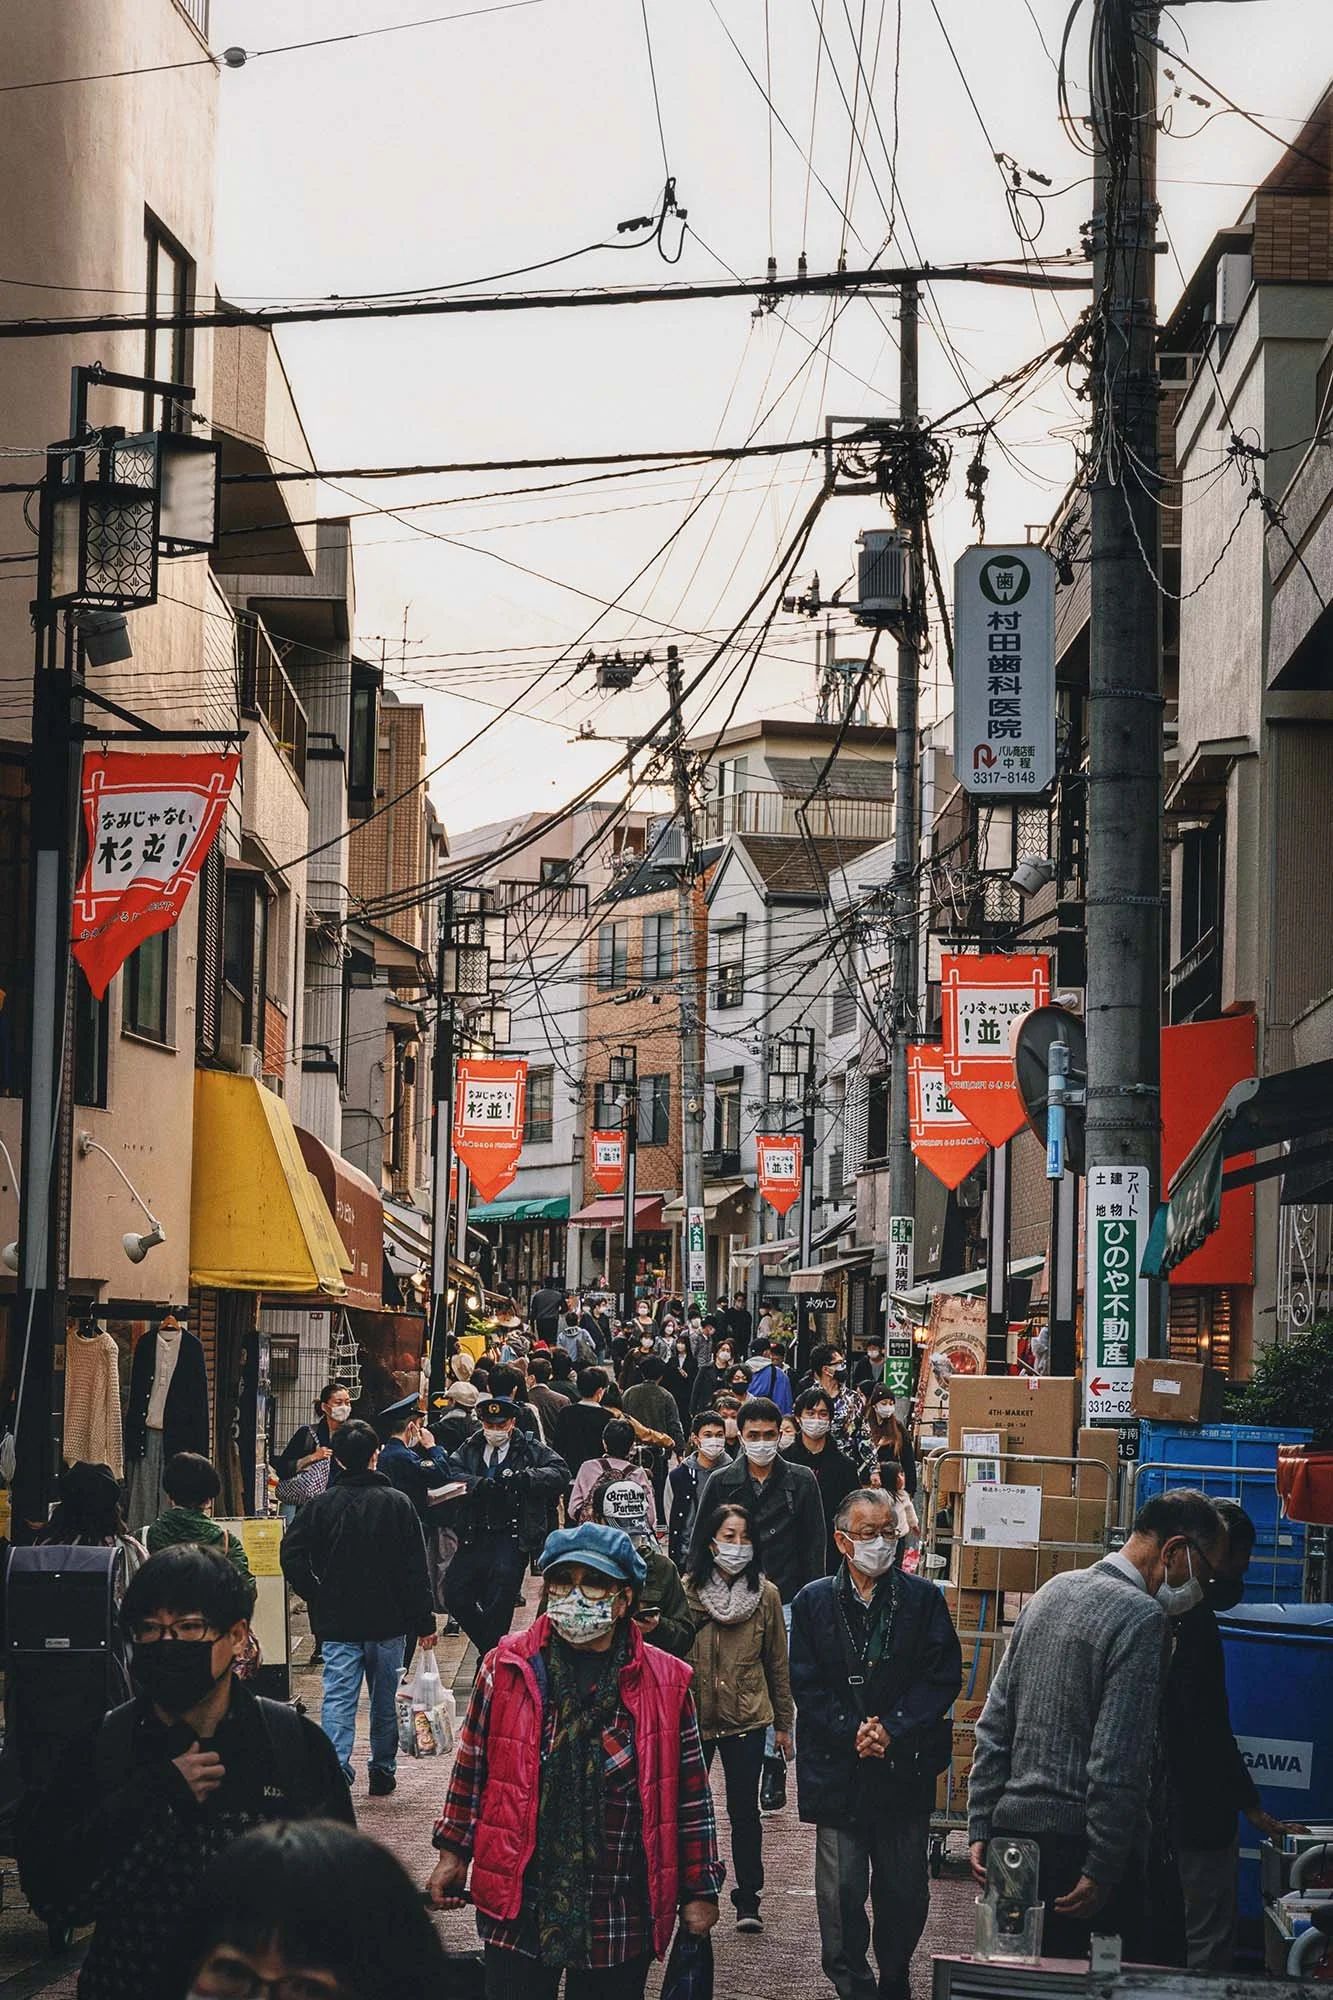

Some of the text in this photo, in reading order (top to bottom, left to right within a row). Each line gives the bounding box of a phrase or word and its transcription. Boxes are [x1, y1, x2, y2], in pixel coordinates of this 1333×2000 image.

[996, 572, 1014, 590] 歯
[987, 611, 1022, 739] 村田歯科医院
[973, 772, 1035, 784] 3317-8148
[1127, 1172, 1139, 1217] アパート
[1102, 1222, 1130, 1366] ひのや不動産
[889, 1369, 909, 1389] 文
